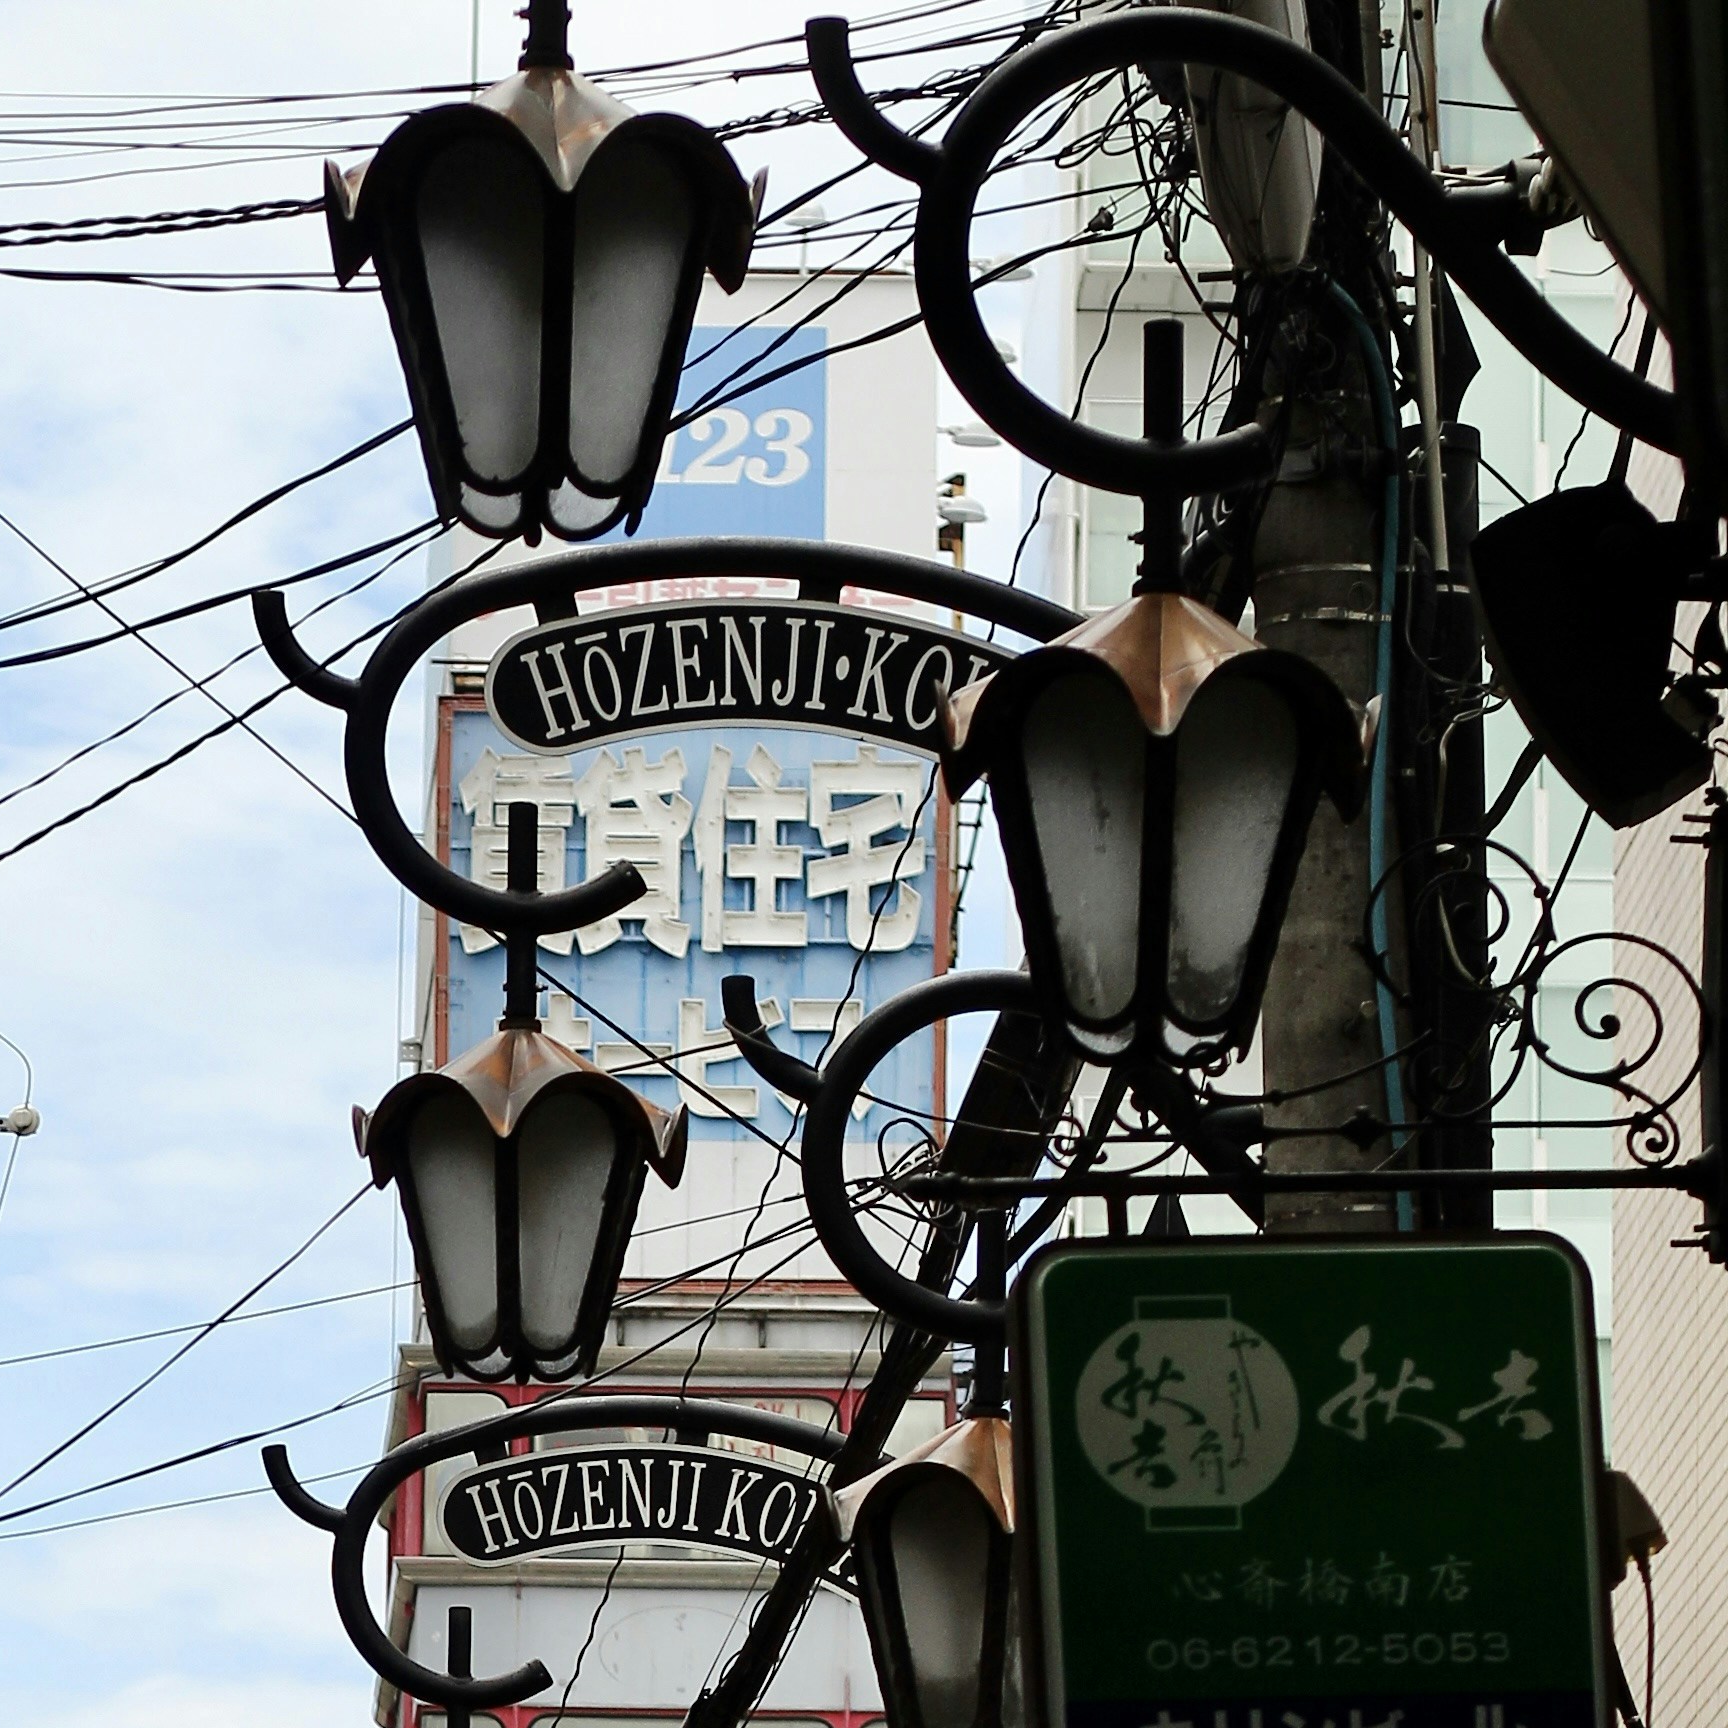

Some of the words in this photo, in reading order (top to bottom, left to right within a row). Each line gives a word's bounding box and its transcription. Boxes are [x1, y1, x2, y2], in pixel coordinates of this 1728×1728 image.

[460, 743, 926, 959] 賃貸住宅
[1147, 1633, 1511, 1672] 06-6212-5053
